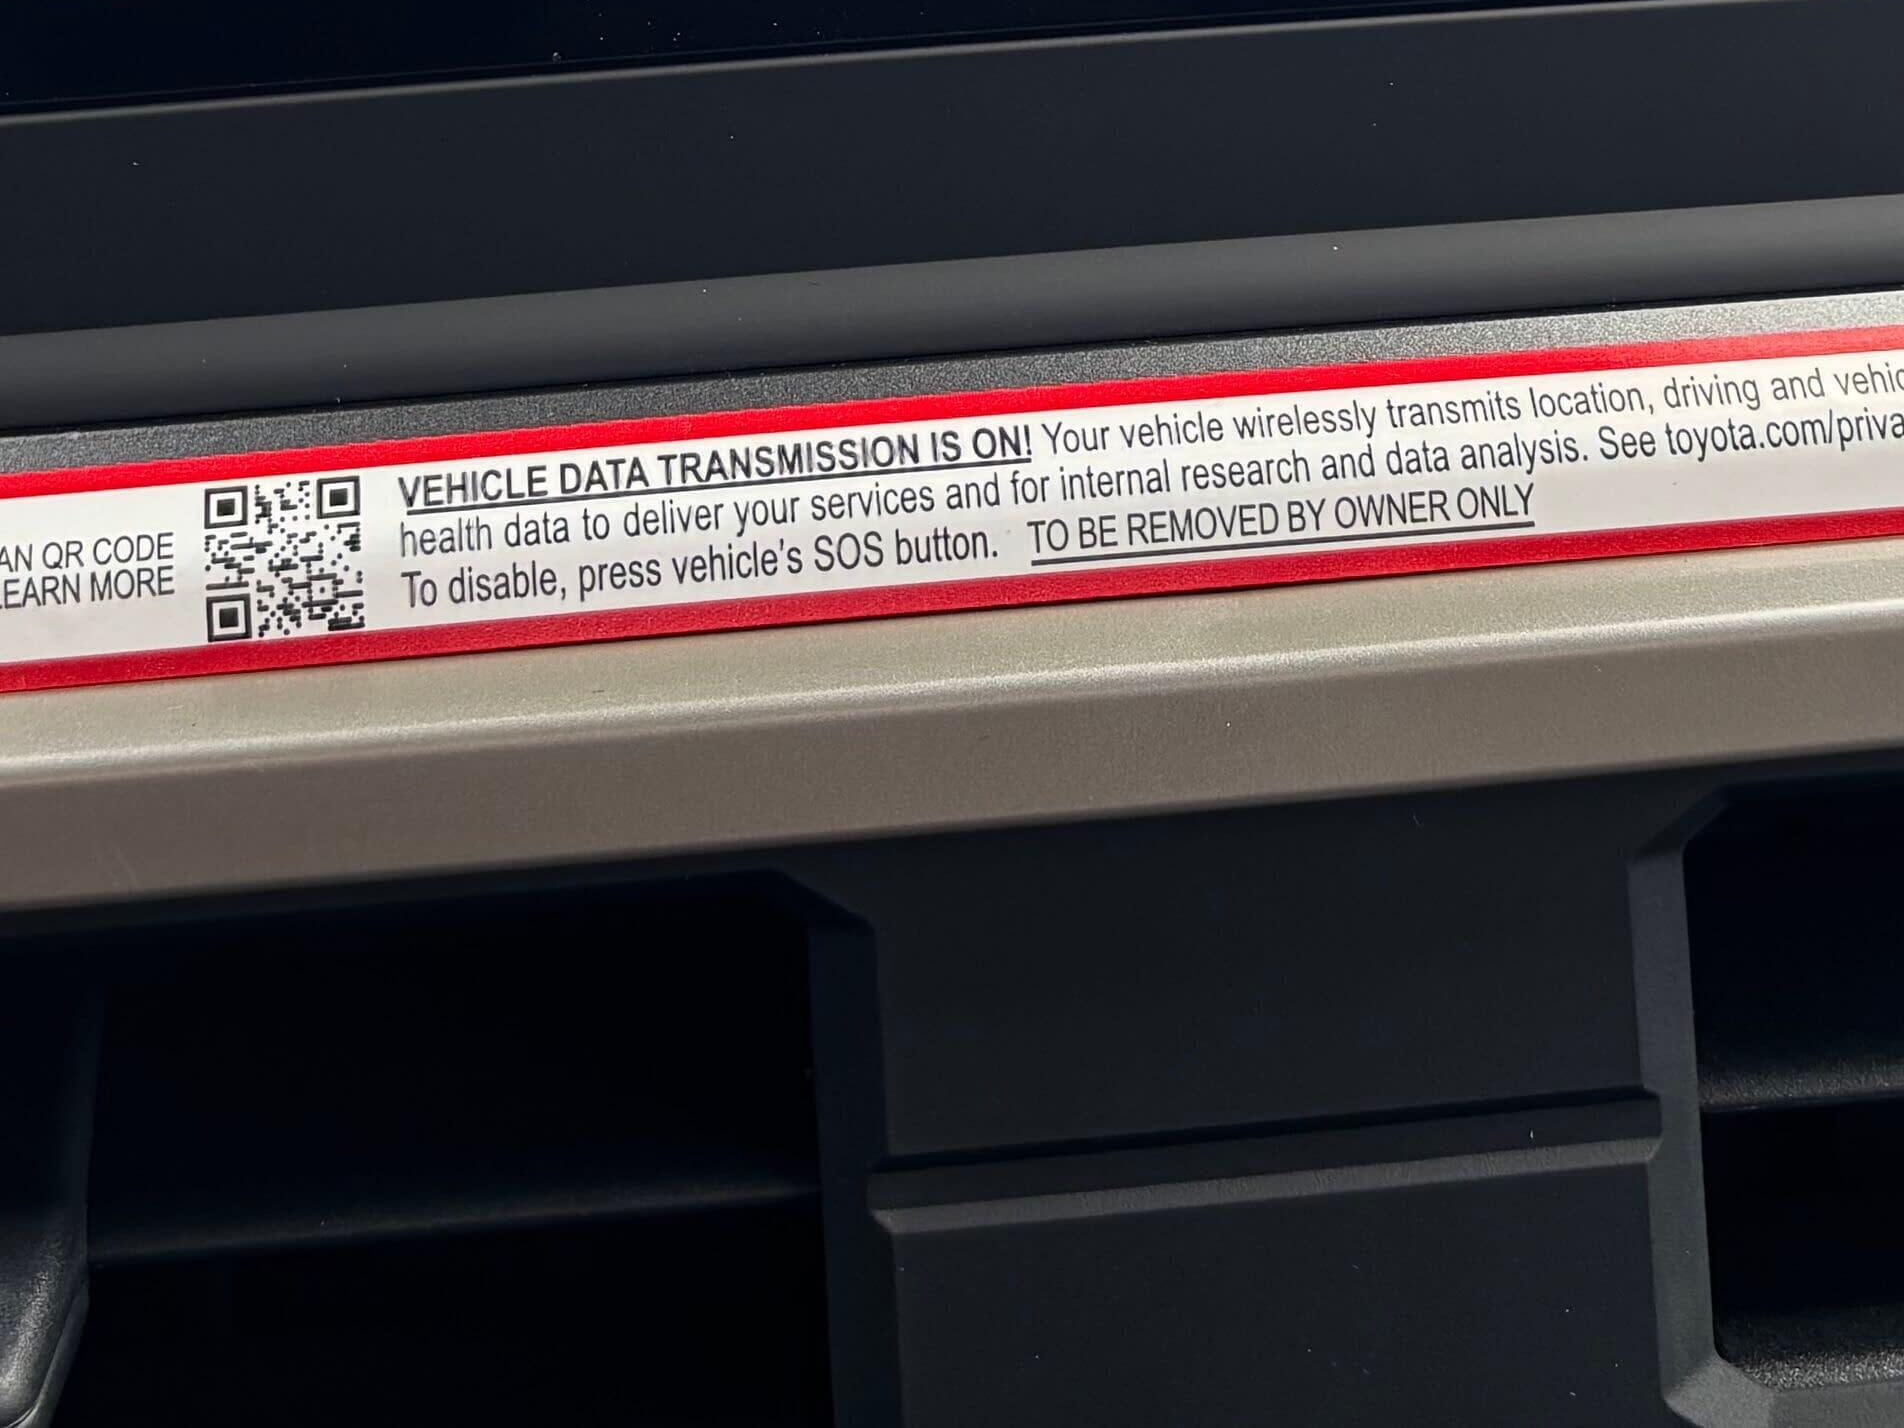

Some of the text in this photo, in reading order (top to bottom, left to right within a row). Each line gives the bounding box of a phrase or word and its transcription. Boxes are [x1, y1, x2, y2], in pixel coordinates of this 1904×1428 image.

[398, 464, 547, 509] VEHICLE
[560, 457, 651, 494] DATA
[657, 441, 920, 486] TRANSMISSION
[931, 431, 961, 463] IS
[973, 425, 1033, 460] ON!
[1041, 421, 1111, 455] Your
[1119, 409, 1225, 448] vehicle
[1232, 400, 1377, 441] wirelessly
[1386, 390, 1522, 430] transmits
[1530, 379, 1656, 418] location,
[1663, 371, 1762, 412] driving
[1771, 366, 1825, 403] and
[400, 517, 493, 557] health
[503, 509, 571, 551] data
[582, 508, 612, 541] to
[622, 497, 728, 537] deliver
[734, 498, 800, 538] your
[811, 482, 936, 522] services
[946, 474, 1001, 511] and
[1011, 473, 1053, 504] for
[1060, 457, 1172, 501] internal
[1182, 449, 1312, 491] research
[1321, 444, 1376, 483] and
[1386, 436, 1452, 476] data
[1461, 430, 1589, 475] analysis.
[1598, 427, 1658, 462] See
[42, 539, 85, 570] QR
[93, 531, 175, 566] CODE
[90, 564, 175, 603] MORE
[401, 482, 1534, 610] To disable, press vehicle's SOS button. TO BE REMOVED BY OWNER ONLY
